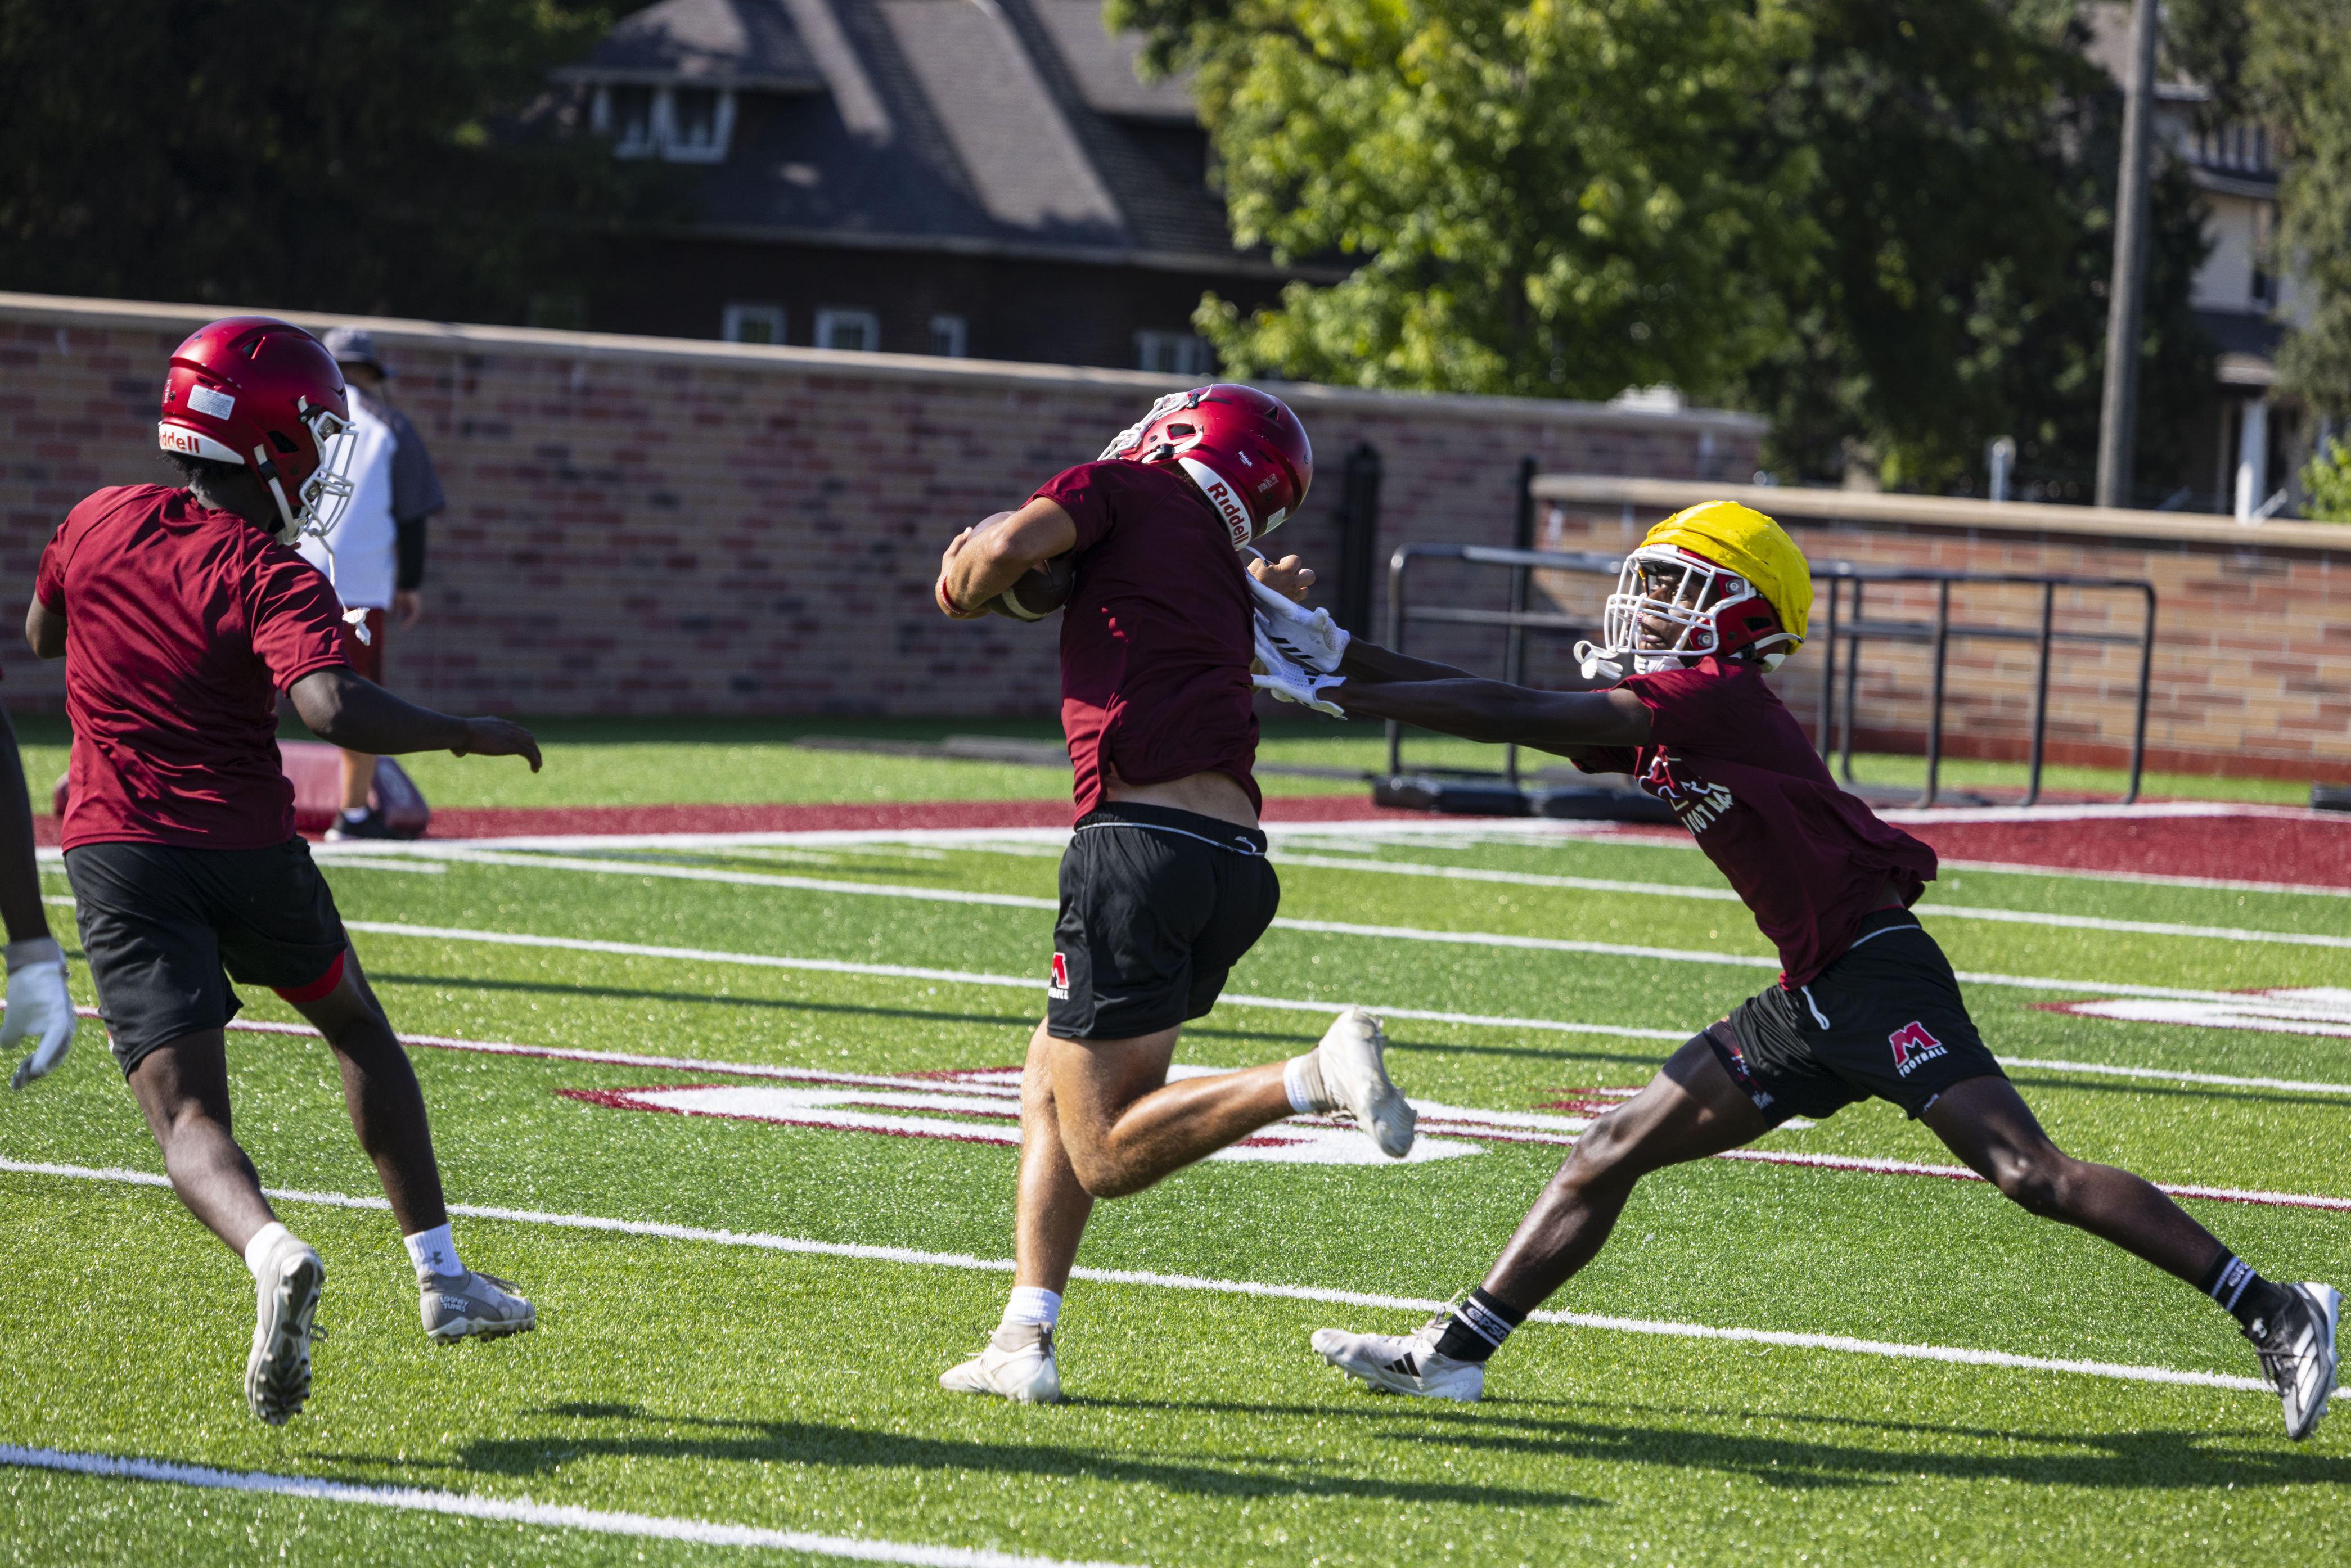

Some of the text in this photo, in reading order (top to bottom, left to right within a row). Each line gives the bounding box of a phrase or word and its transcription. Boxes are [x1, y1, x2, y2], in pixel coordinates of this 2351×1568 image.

[1207, 481, 1249, 545] Riddell
[1888, 1020, 1942, 1069] M
[1899, 1046, 1948, 1078] FOOTBALL
[1478, 1315, 1508, 1341] PSD
